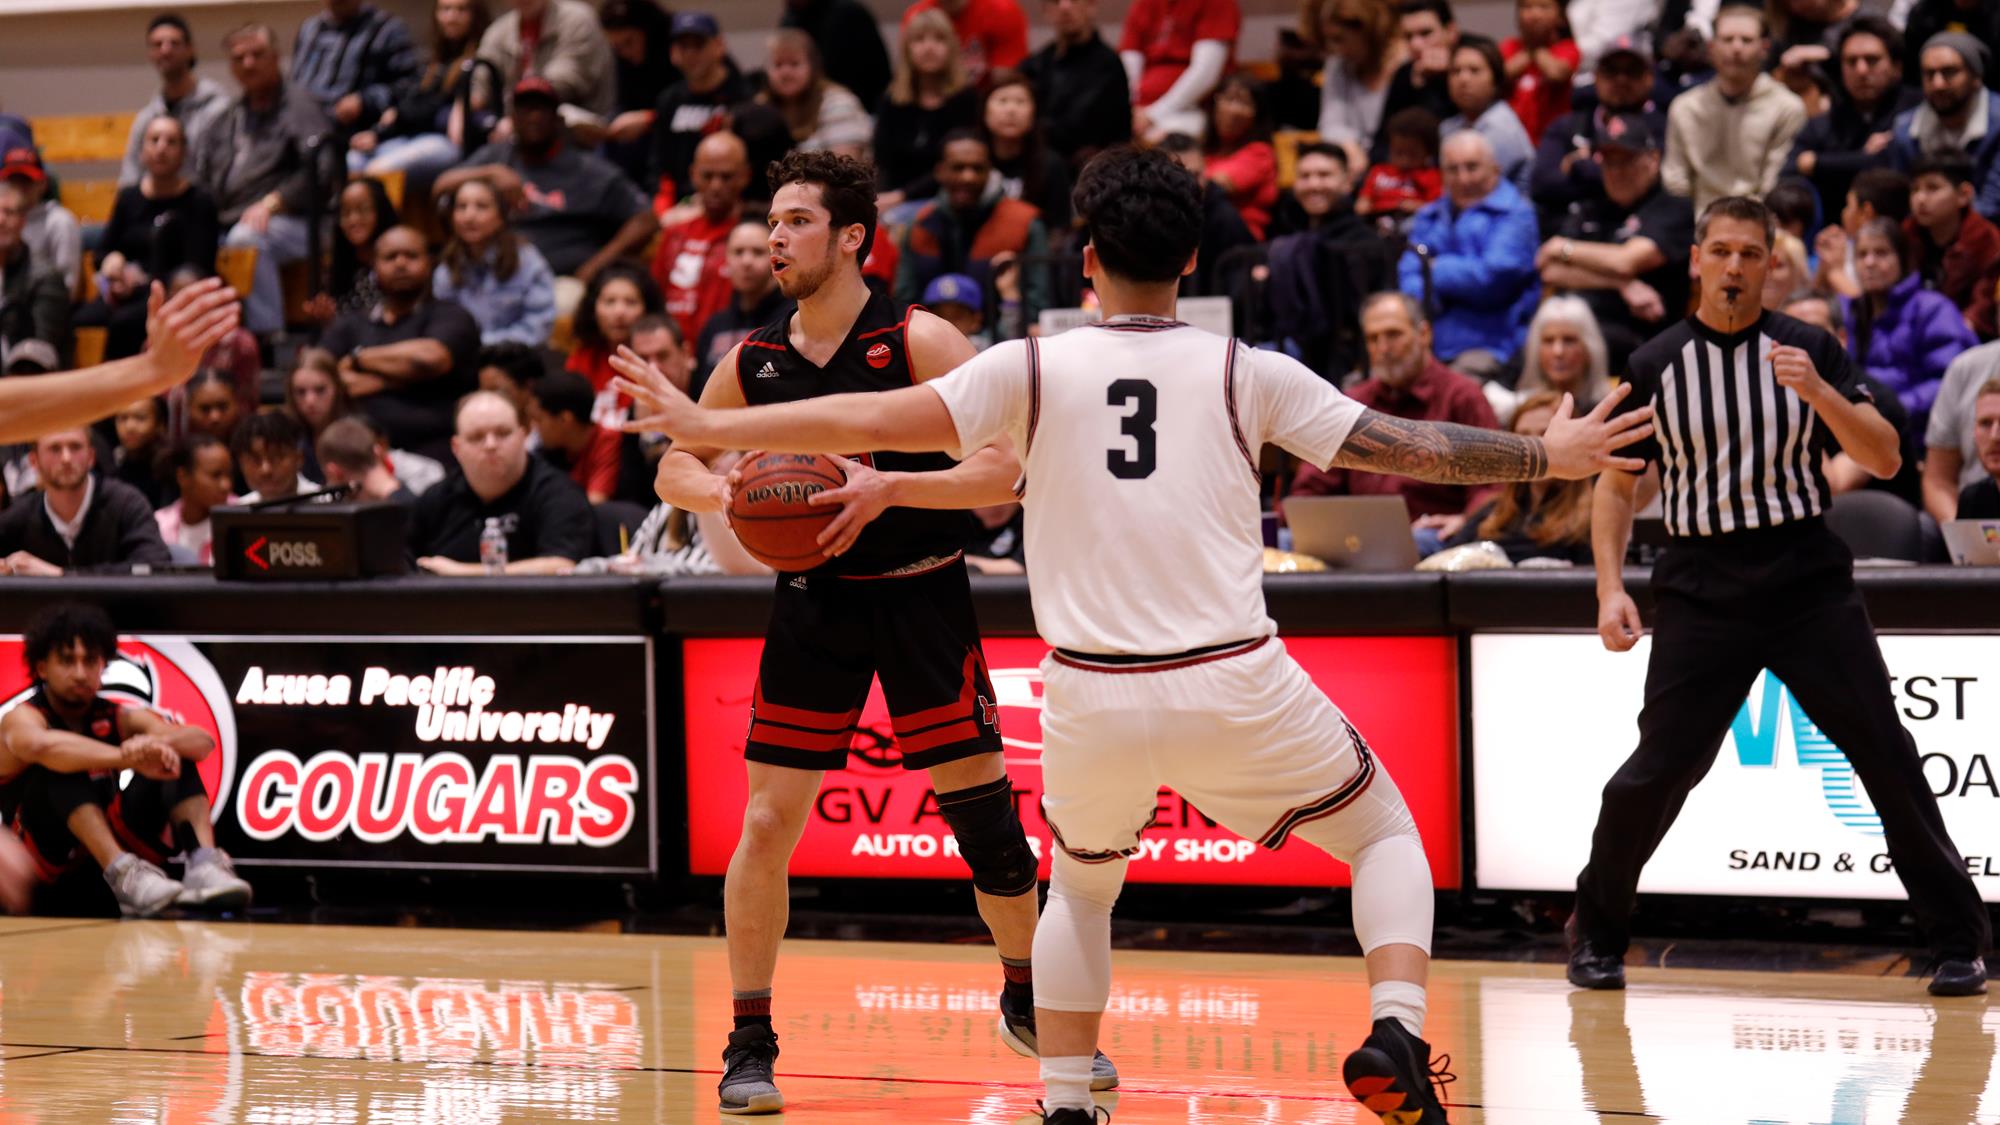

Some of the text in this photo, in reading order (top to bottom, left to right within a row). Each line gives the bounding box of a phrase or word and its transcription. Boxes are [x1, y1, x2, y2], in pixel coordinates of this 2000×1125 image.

[1107, 379, 1157, 479] 3
[746, 480, 826, 505] Wilson
[269, 541, 322, 566] POSS.
[236, 666, 496, 706] Azusa Pacific
[1889, 676, 1979, 721] ST
[415, 703, 615, 750] University
[1919, 752, 2000, 798] OA
[236, 750, 639, 847] COUGARS
[816, 788, 892, 824] GV
[851, 834, 938, 858] AUTO
[1174, 839, 1257, 863] SHOP
[1728, 849, 1821, 871] SAND
[1833, 852, 1856, 873] &
